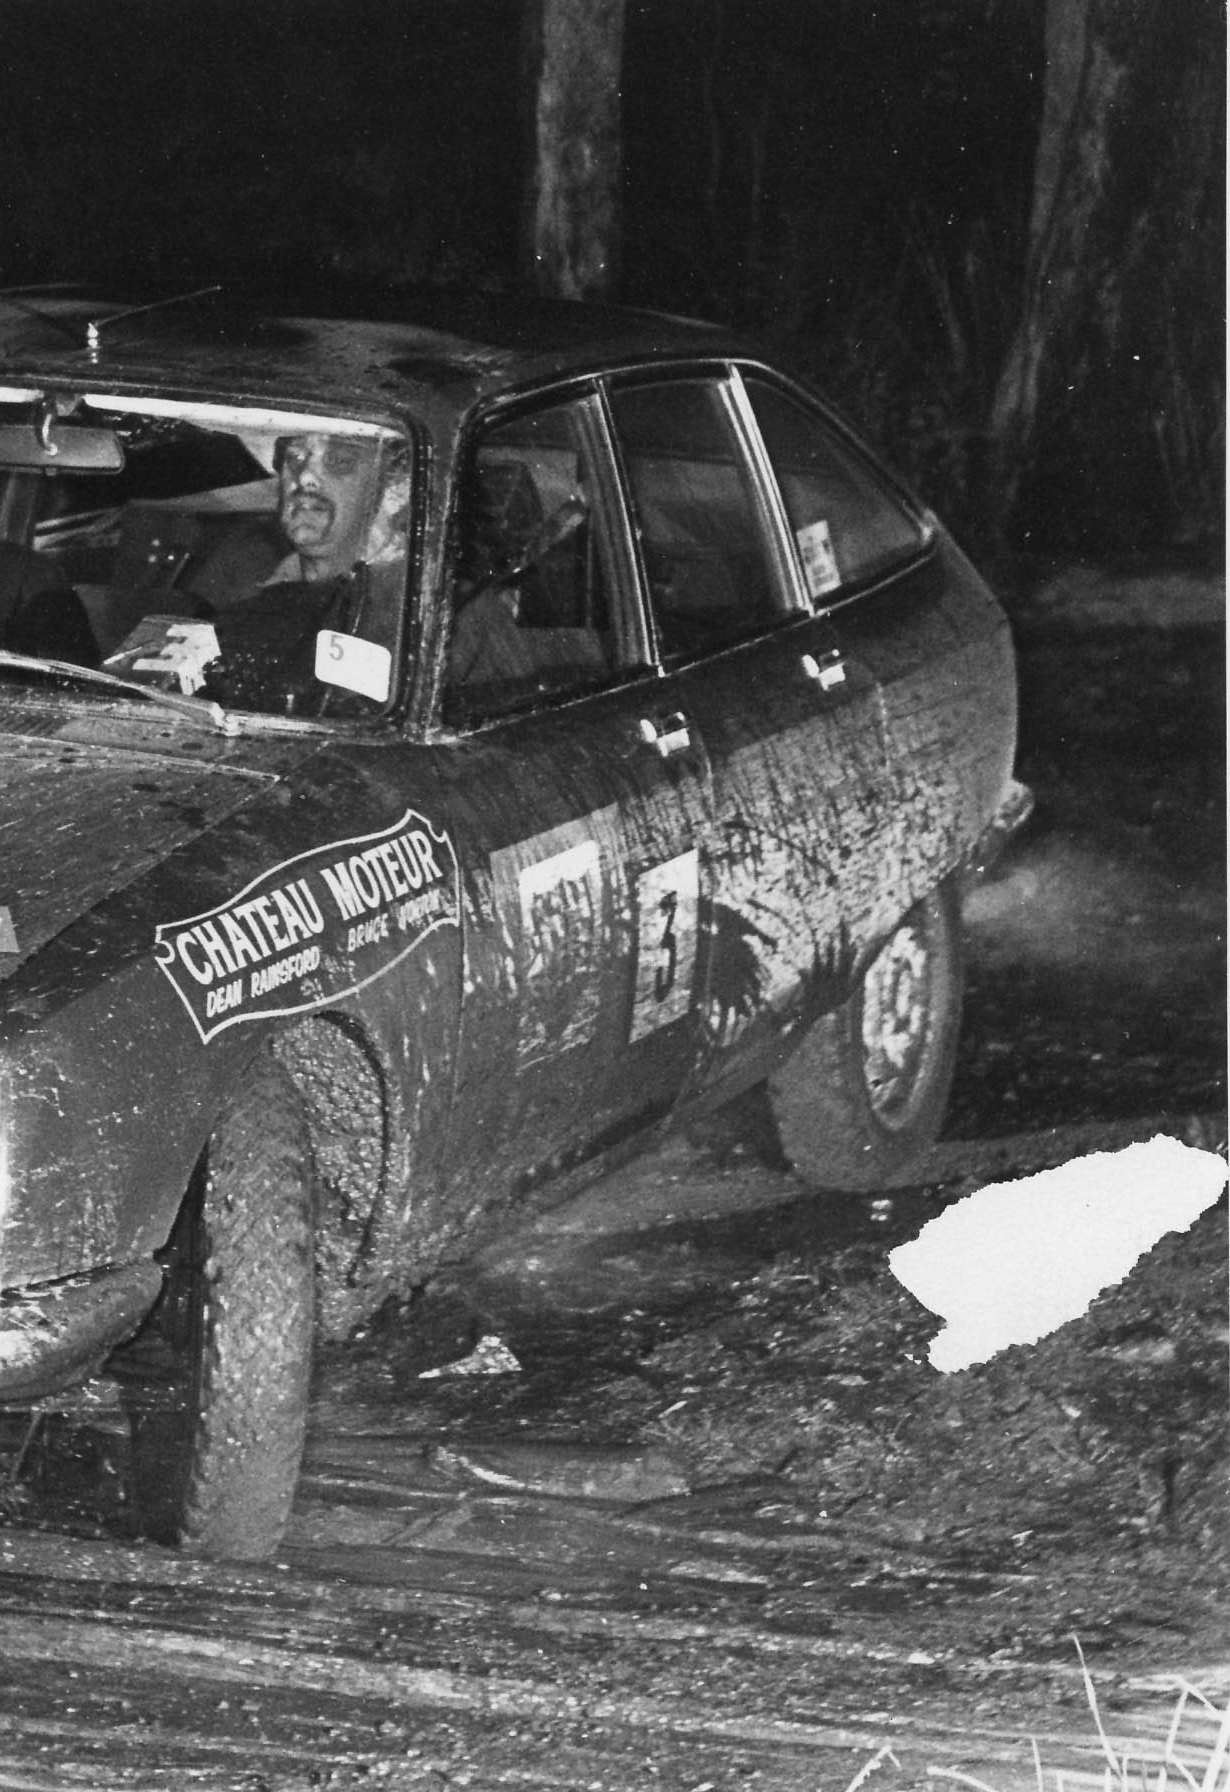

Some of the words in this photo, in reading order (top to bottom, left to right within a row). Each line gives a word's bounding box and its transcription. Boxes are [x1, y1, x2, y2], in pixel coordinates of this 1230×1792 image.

[329, 634, 345, 661] 5
[176, 878, 325, 985] CHATEAU
[320, 830, 443, 920] MOTEUR
[206, 978, 243, 1018] DEAN
[250, 945, 321, 998] RAINSFORD
